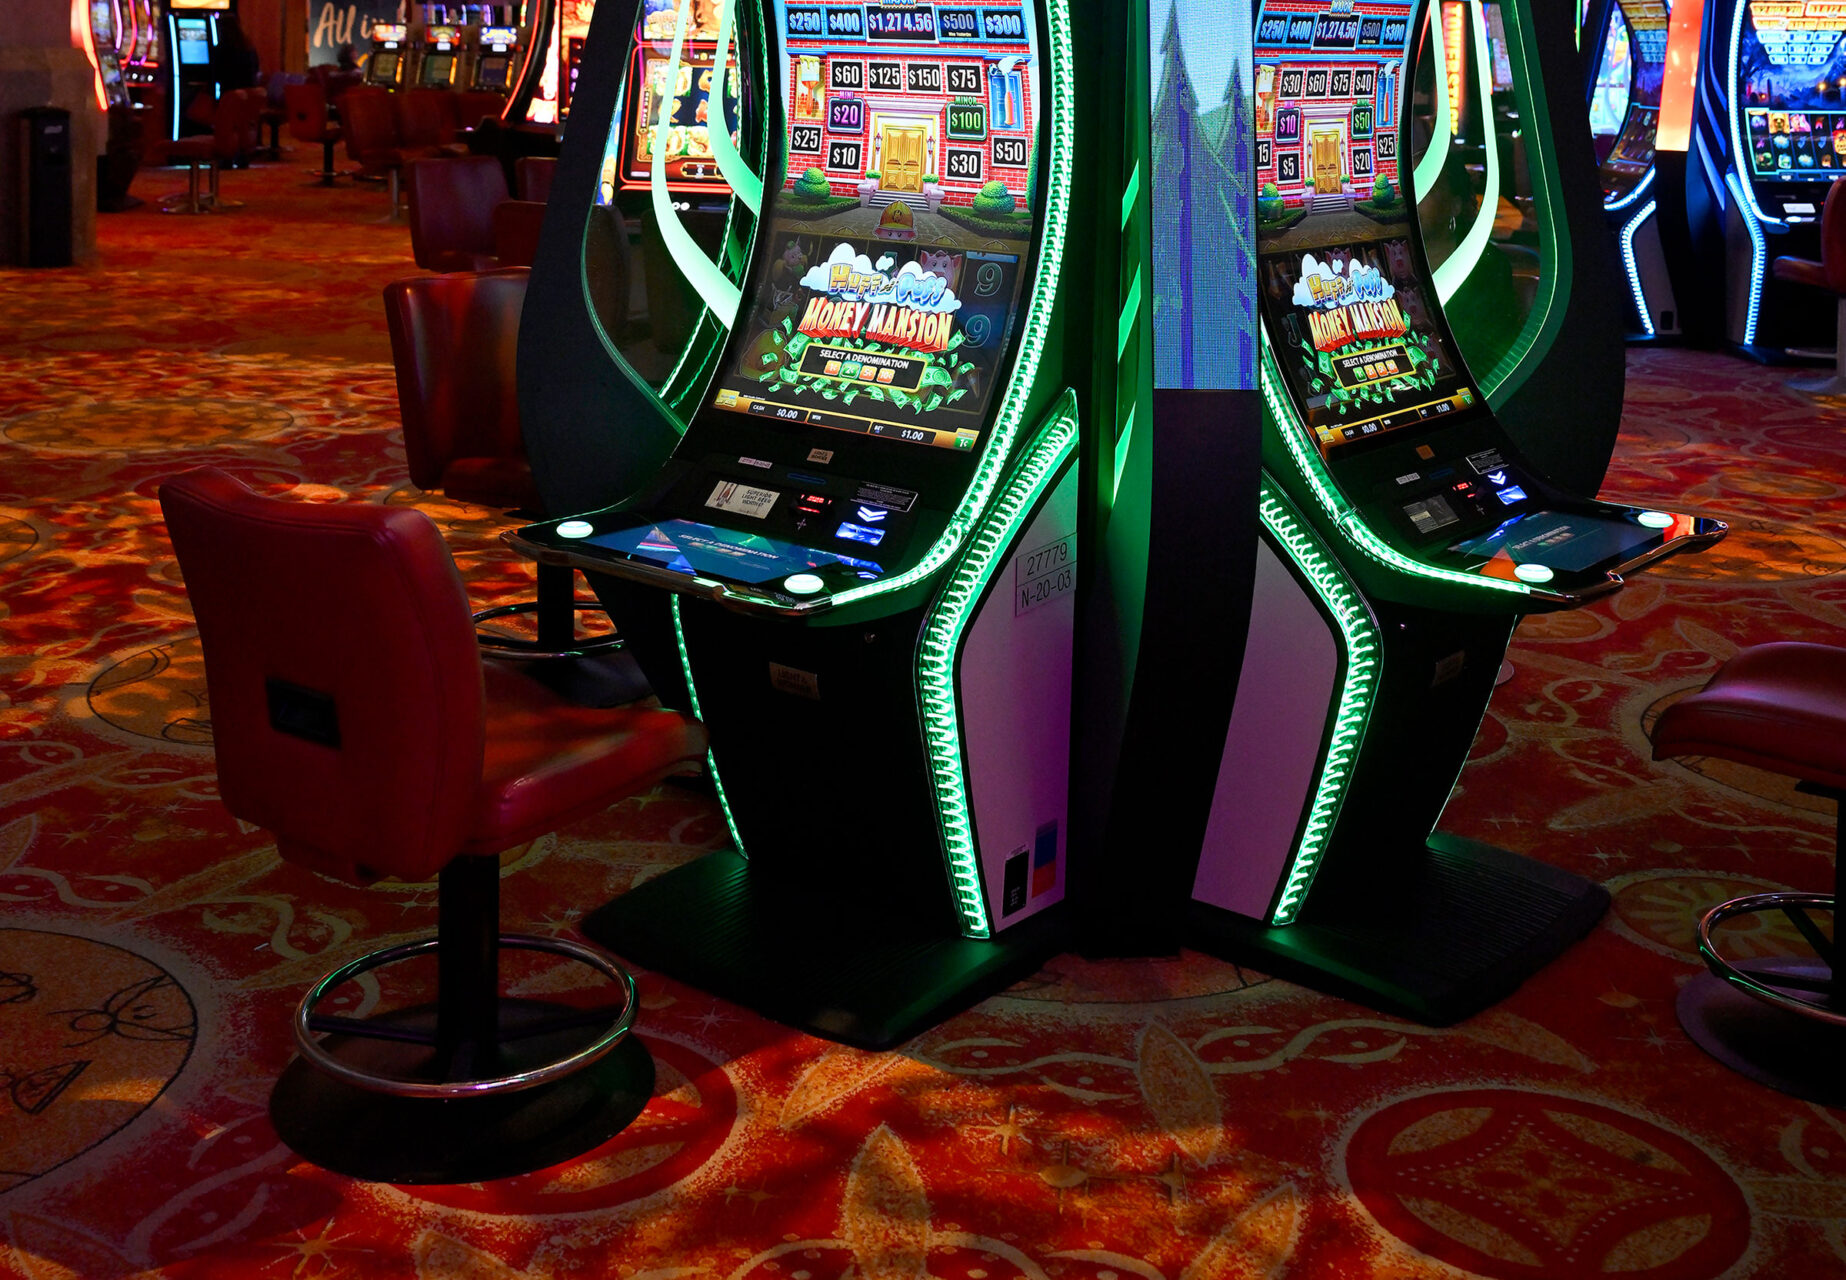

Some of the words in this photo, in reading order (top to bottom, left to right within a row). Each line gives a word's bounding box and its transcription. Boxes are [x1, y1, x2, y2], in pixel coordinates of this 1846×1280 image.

[313, 2, 356, 48] All
[789, 12, 821, 32] $250
[830, 13, 860, 32] $400
[869, 13, 933, 33] $1,274.56
[943, 14, 975, 30] $500
[985, 15, 1021, 35] $300
[1260, 19, 1286, 40] $250
[1289, 21, 1312, 40] $400
[1316, 21, 1358, 40] $1,274.56
[1361, 22, 1381, 37] $500
[1385, 24, 1405, 41] $300
[835, 65, 860, 85] $60
[870, 67, 900, 86] $125
[909, 68, 939, 87] $150
[951, 70, 977, 89] $75
[1282, 74, 1301, 93] $30
[1308, 74, 1326, 93] $60
[1333, 73, 1349, 92] $75
[1355, 74, 1372, 92] $40
[833, 105, 859, 124] $20
[951, 111, 982, 130] $100
[1354, 111, 1370, 130] $50
[1279, 116, 1296, 135] $10
[794, 126, 819, 149] $25
[1378, 136, 1394, 155] $25
[832, 144, 856, 166] $10
[995, 141, 1024, 162] $50
[950, 154, 978, 175] $30
[1283, 157, 1295, 176] $5
[1354, 152, 1371, 171] $20
[976, 262, 1003, 296] 9
[797, 297, 871, 339] MONEY
[964, 314, 991, 348] 9
[1308, 306, 1354, 353] MONEY
[819, 349, 846, 360] SELECT
[851, 354, 909, 369] DENOMINATION
[1342, 357, 1360, 368] SELECT
[1363, 349, 1399, 363] DENOMINATION
[752, 404, 766, 412] CASH
[776, 408, 799, 420] $0.00
[901, 429, 924, 441] $1.00
[746, 489, 772, 499] SUPERIOR
[1027, 542, 1068, 576] 27779
[1021, 569, 1071, 608] N-20-03
